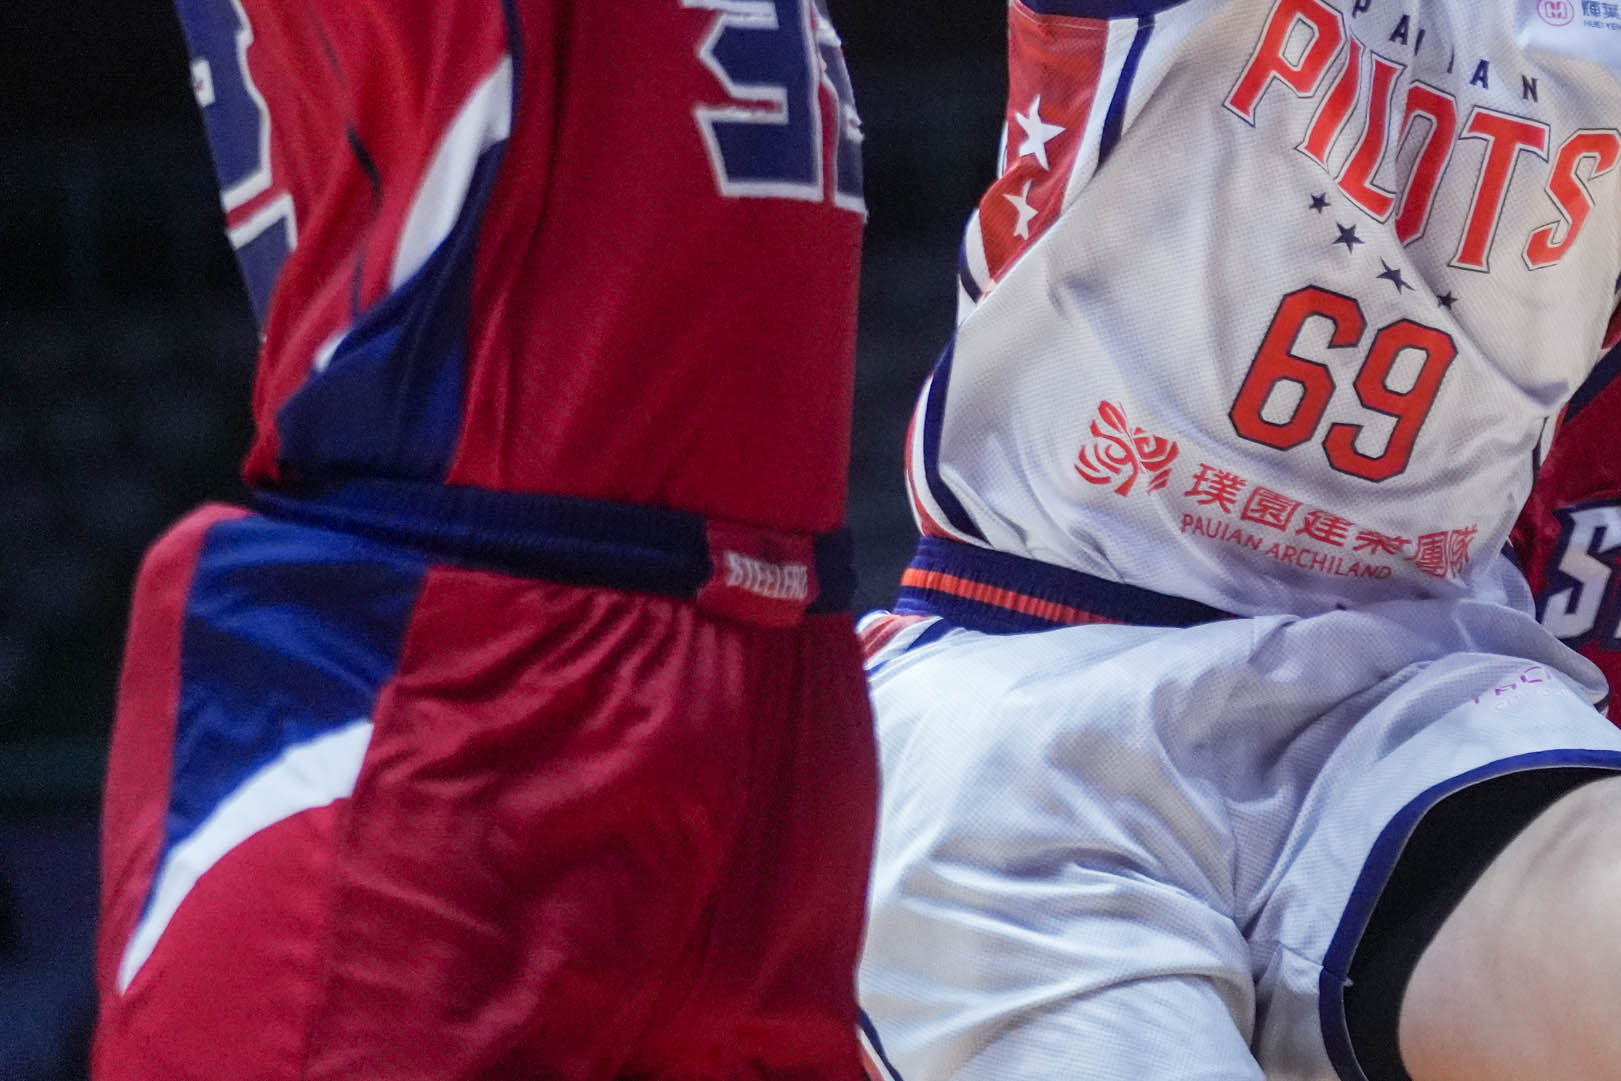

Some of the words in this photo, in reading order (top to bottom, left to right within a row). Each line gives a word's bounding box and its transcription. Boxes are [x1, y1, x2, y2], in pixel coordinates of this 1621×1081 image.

[1228, 284, 1458, 483] 69
[1181, 513, 1264, 552] PAUIAN
[1265, 542, 1393, 580] ARCHILAND
